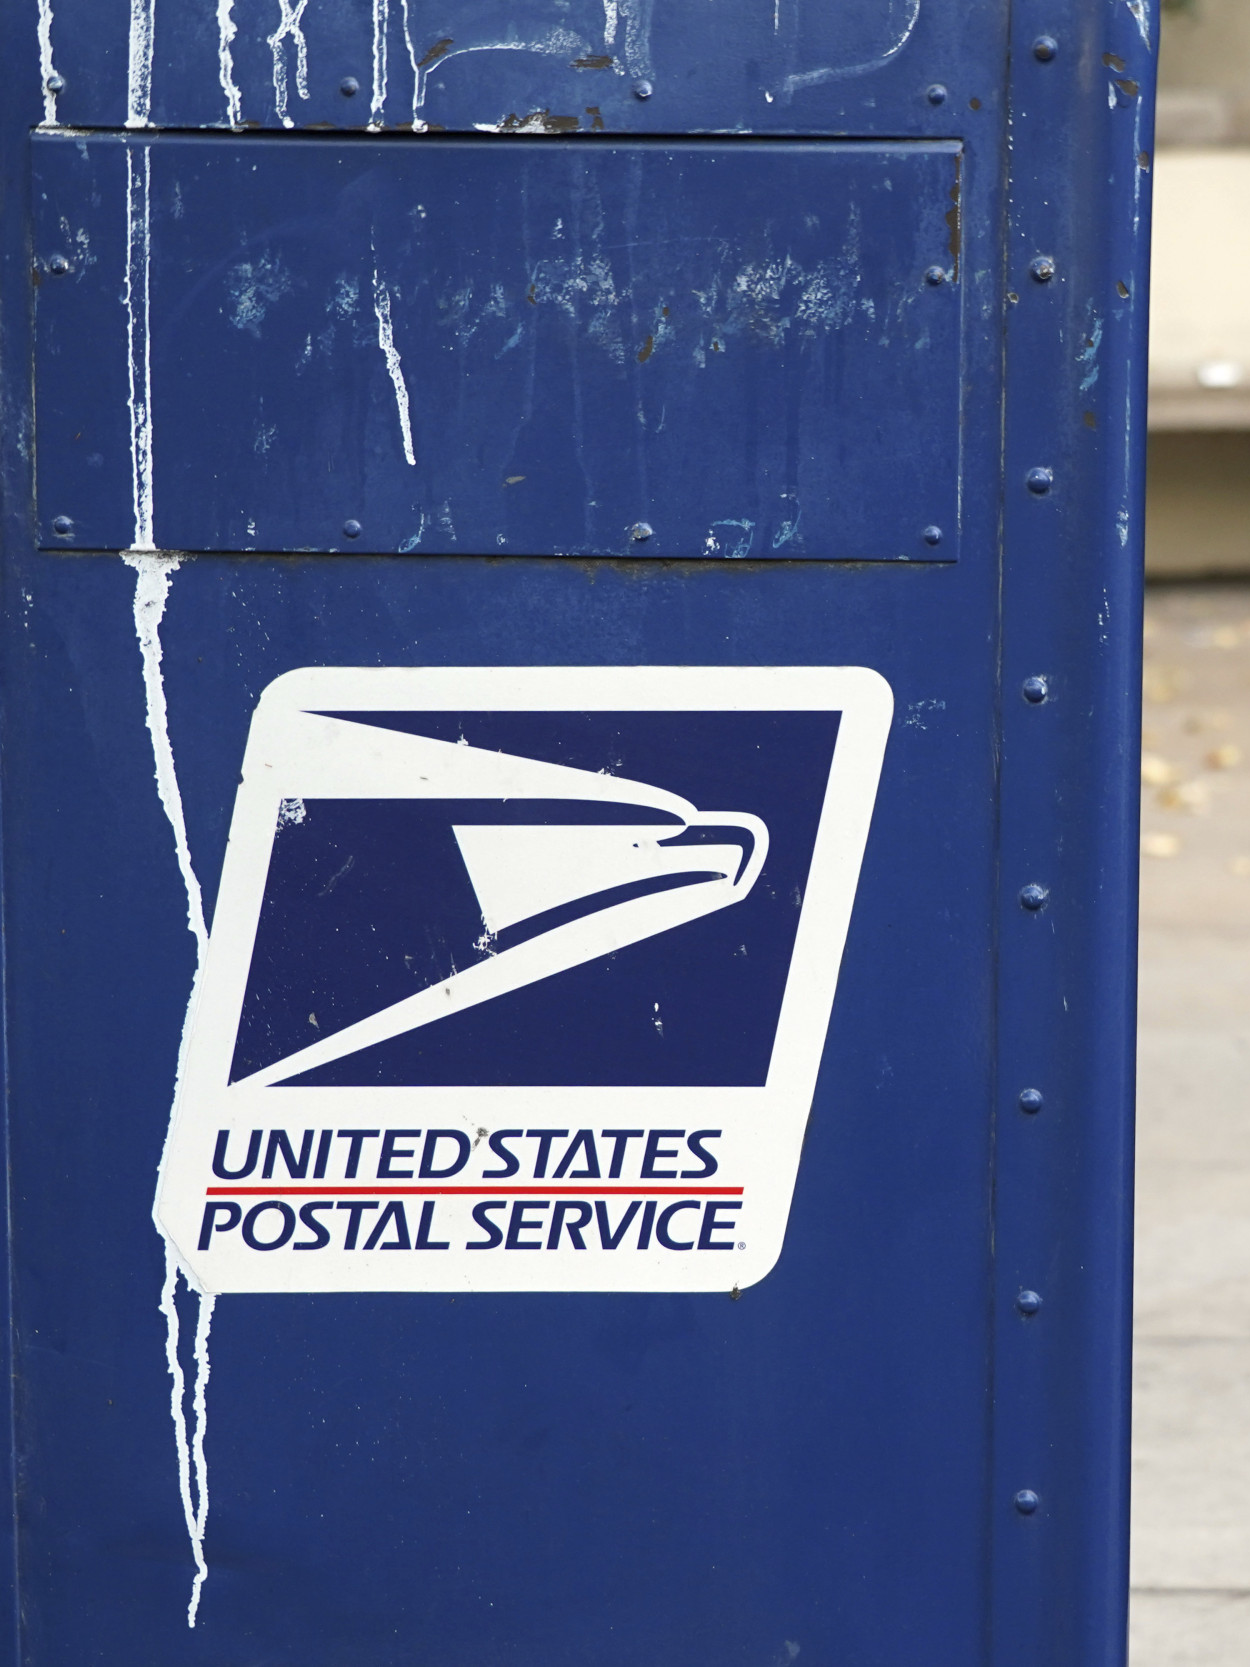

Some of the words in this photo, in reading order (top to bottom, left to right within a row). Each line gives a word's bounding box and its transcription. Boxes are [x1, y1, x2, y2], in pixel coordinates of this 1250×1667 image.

[211, 1129, 471, 1180] UNITED
[481, 1128, 723, 1180] STATES
[197, 1200, 451, 1252] POSTAL
